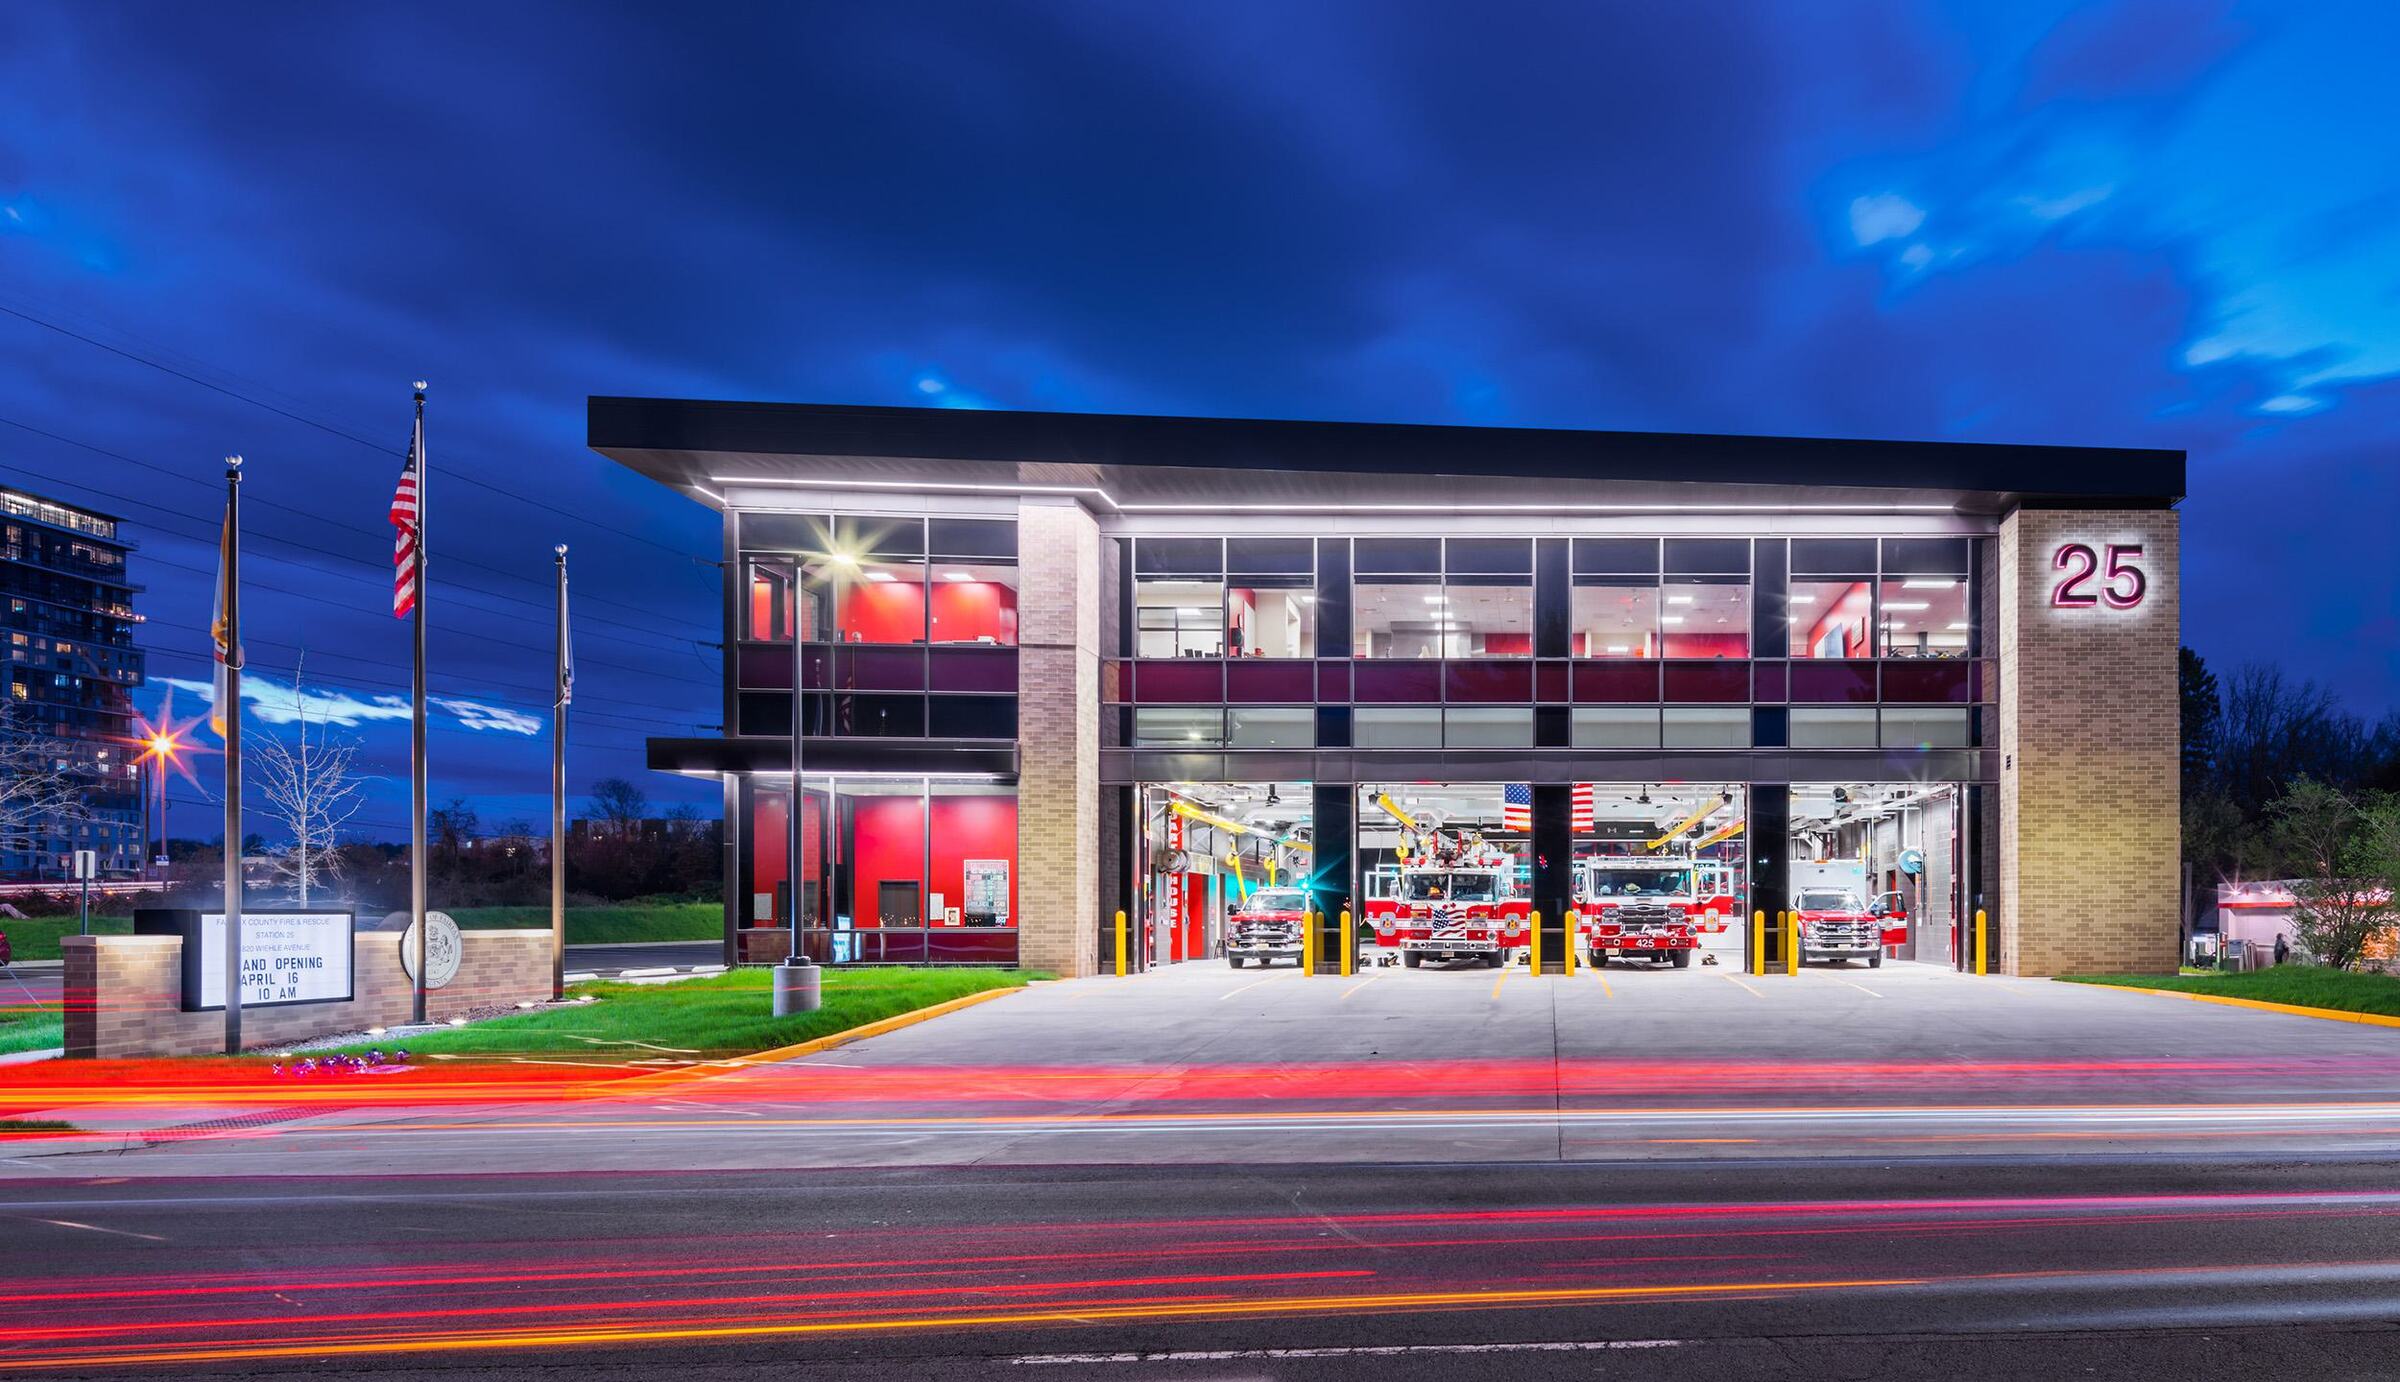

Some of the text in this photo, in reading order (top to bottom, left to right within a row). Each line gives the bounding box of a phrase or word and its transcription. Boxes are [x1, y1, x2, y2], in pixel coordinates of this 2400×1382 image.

[2052, 543, 2147, 609] 25
[248, 918, 279, 926] COUNTY
[255, 931, 285, 939] STATION
[256, 944, 282, 952] WIEHLE
[283, 943, 310, 951] AVENUE
[1635, 938, 1656, 948] 425
[243, 957, 323, 971] AND OPENING
[242, 971, 299, 986] APRIL 16
[259, 986, 296, 1000] 10 AM
